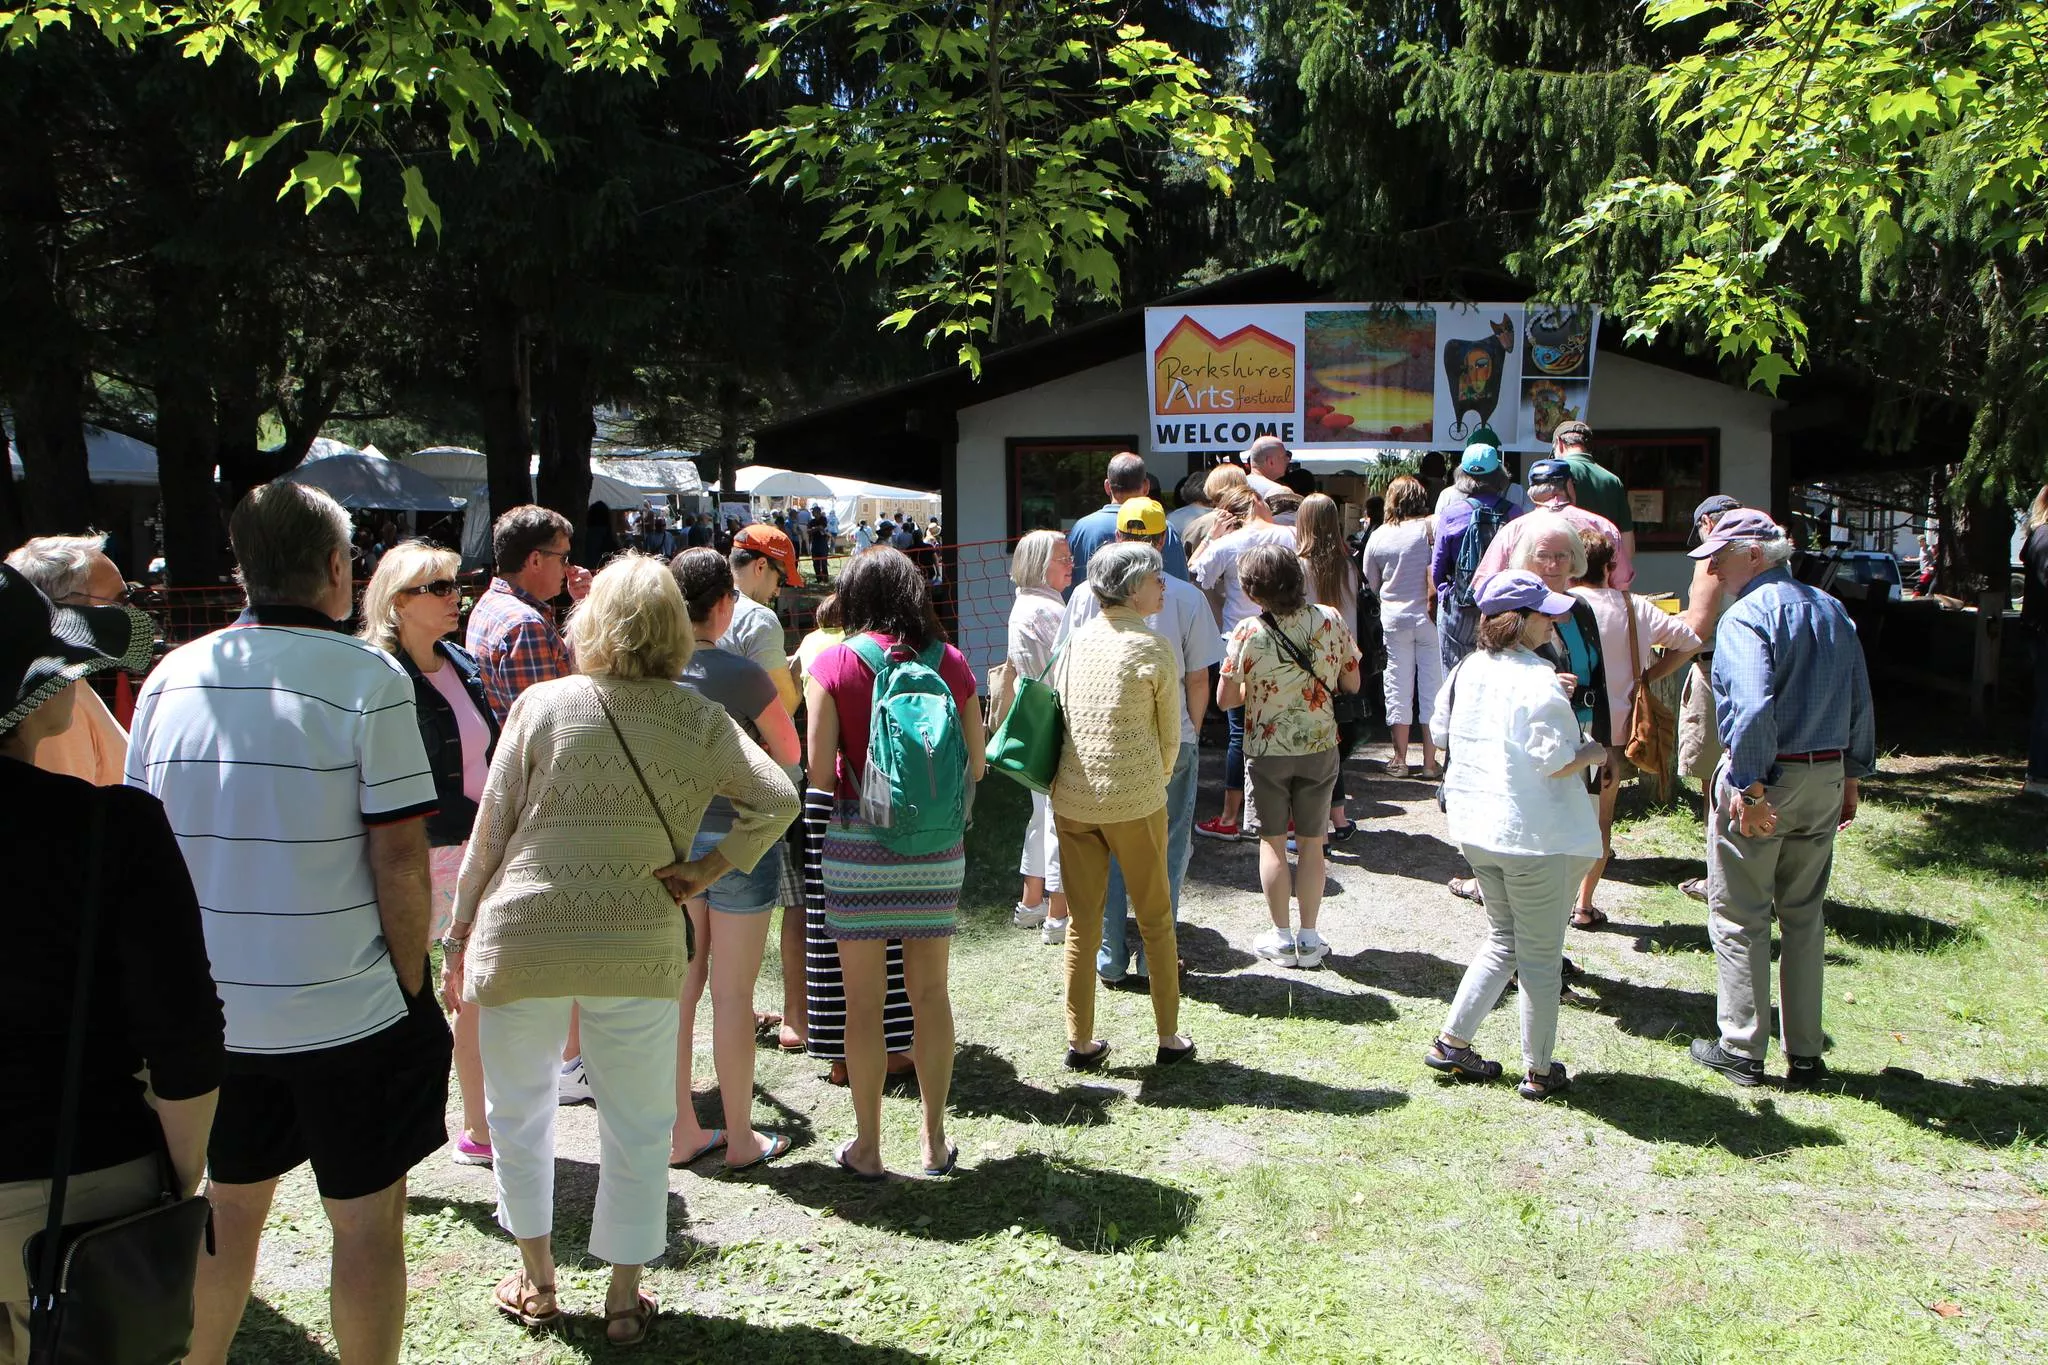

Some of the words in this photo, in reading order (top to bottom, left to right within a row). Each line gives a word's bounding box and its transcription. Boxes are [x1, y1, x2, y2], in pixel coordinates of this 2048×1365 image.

[1158, 352, 1292, 400] Berkshires
[1164, 378, 1235, 409] Arts
[1236, 385, 1292, 411] festival
[1156, 422, 1294, 444] WELCOME
